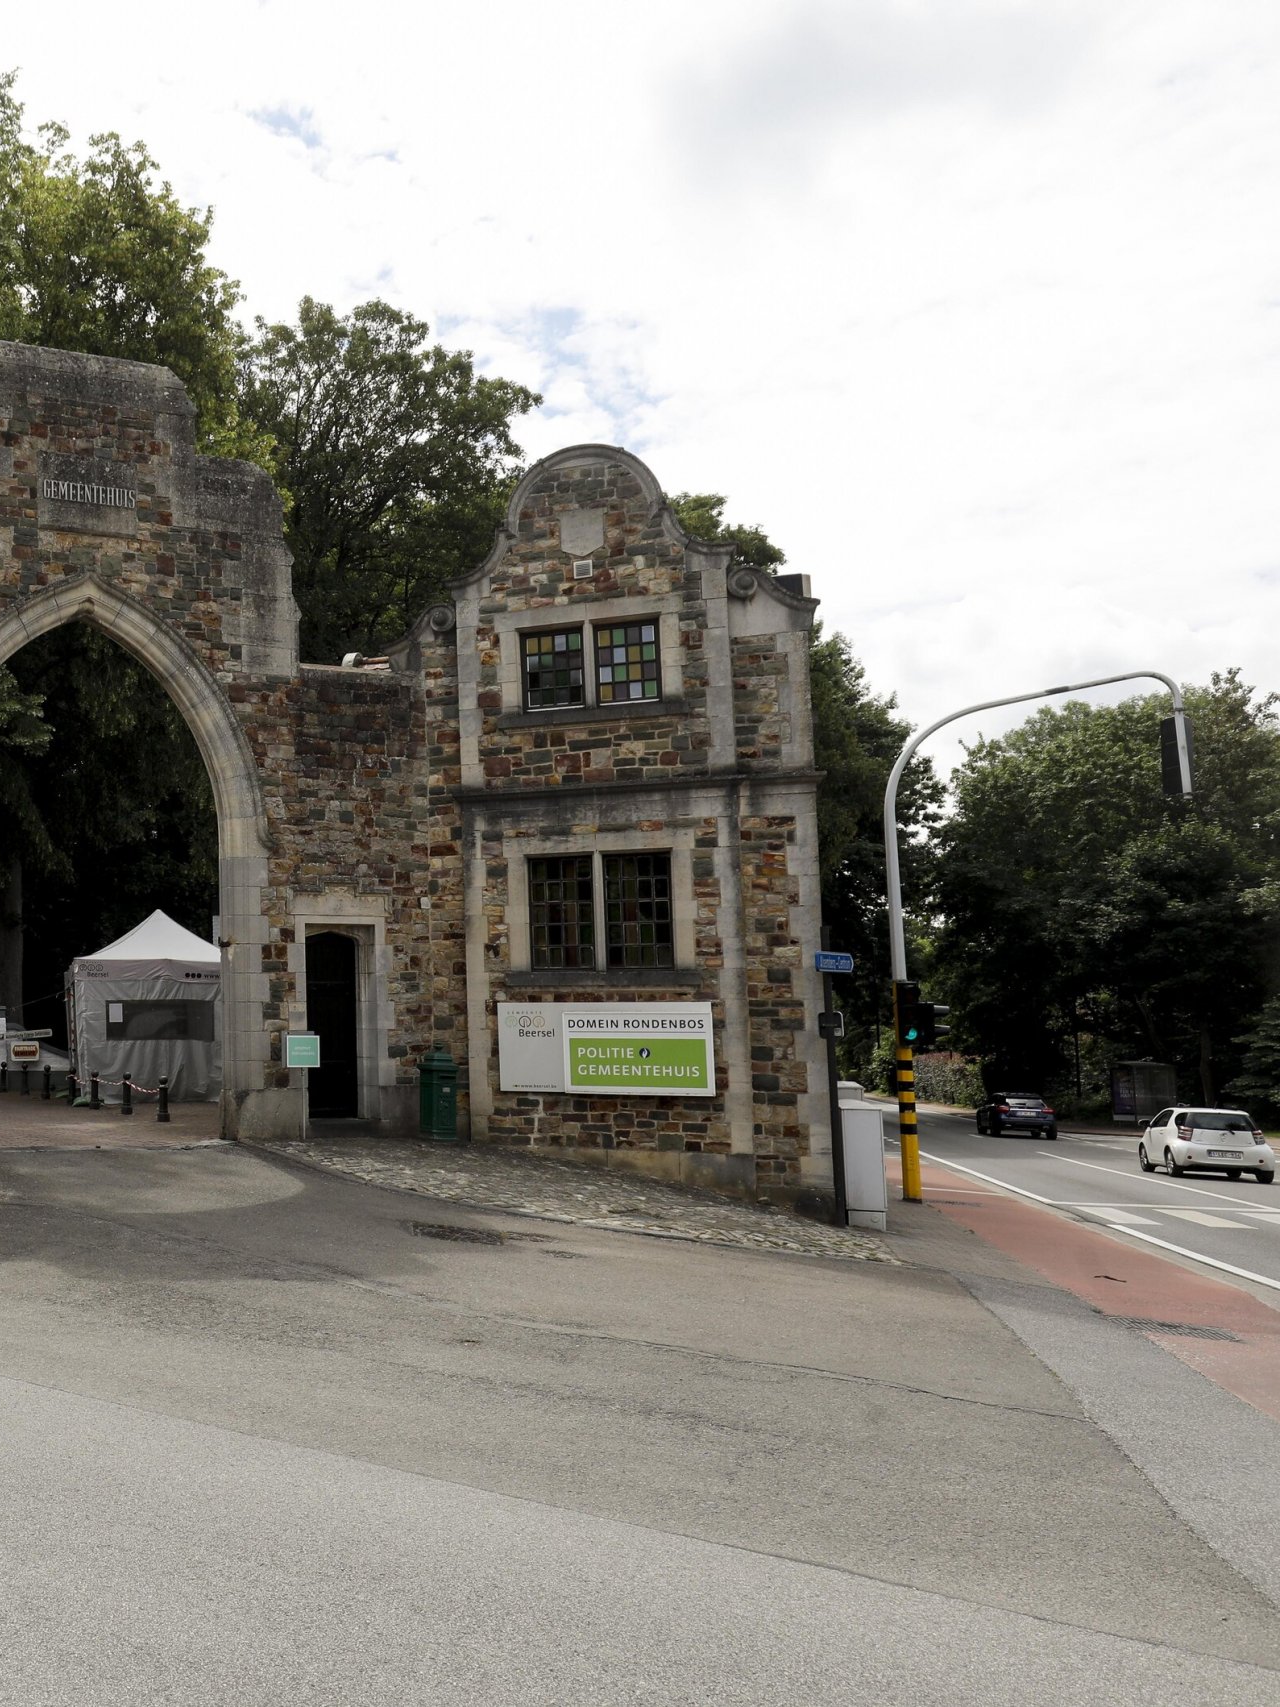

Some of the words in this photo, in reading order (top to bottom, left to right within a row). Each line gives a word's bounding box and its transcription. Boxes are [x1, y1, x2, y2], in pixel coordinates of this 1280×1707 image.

[43, 479, 135, 509] GEMEENTEHUIS
[567, 1019, 619, 1029] DOMEIN
[623, 1019, 705, 1029] RONDENBOS
[518, 1028, 555, 1038] Beersel
[577, 1047, 634, 1058] POLITIE
[577, 1064, 700, 1077] GEMEENTEHUIS
